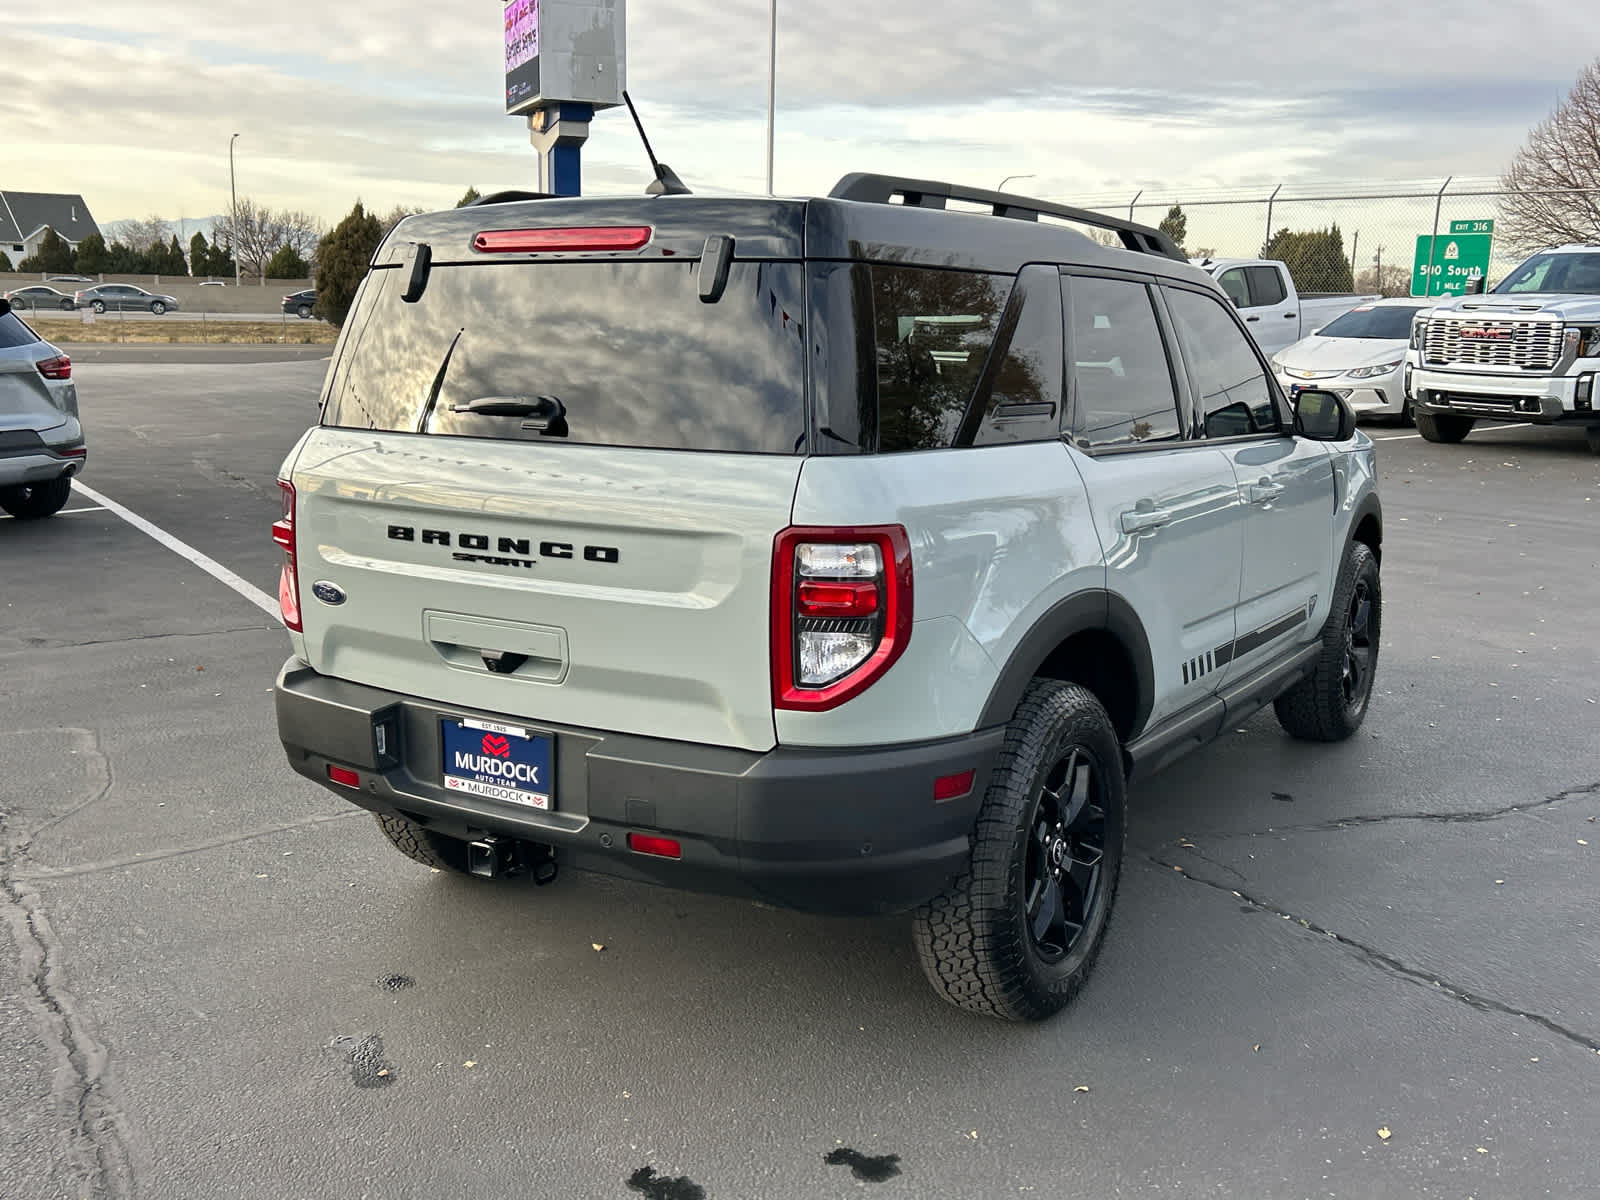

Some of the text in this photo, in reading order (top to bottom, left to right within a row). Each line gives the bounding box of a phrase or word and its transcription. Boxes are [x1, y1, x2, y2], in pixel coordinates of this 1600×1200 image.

[1455, 222, 1488, 231] EXIT 316
[1447, 264, 1481, 276] South
[1436, 281, 1461, 290] 1 MILE
[1460, 327, 1511, 339] GMC
[387, 525, 619, 564] BRONCO
[452, 552, 537, 569] SPORT
[455, 751, 539, 784] MURDOCK
[475, 774, 516, 788] AUTO TEAM
[467, 782, 524, 803] MURDOCK
